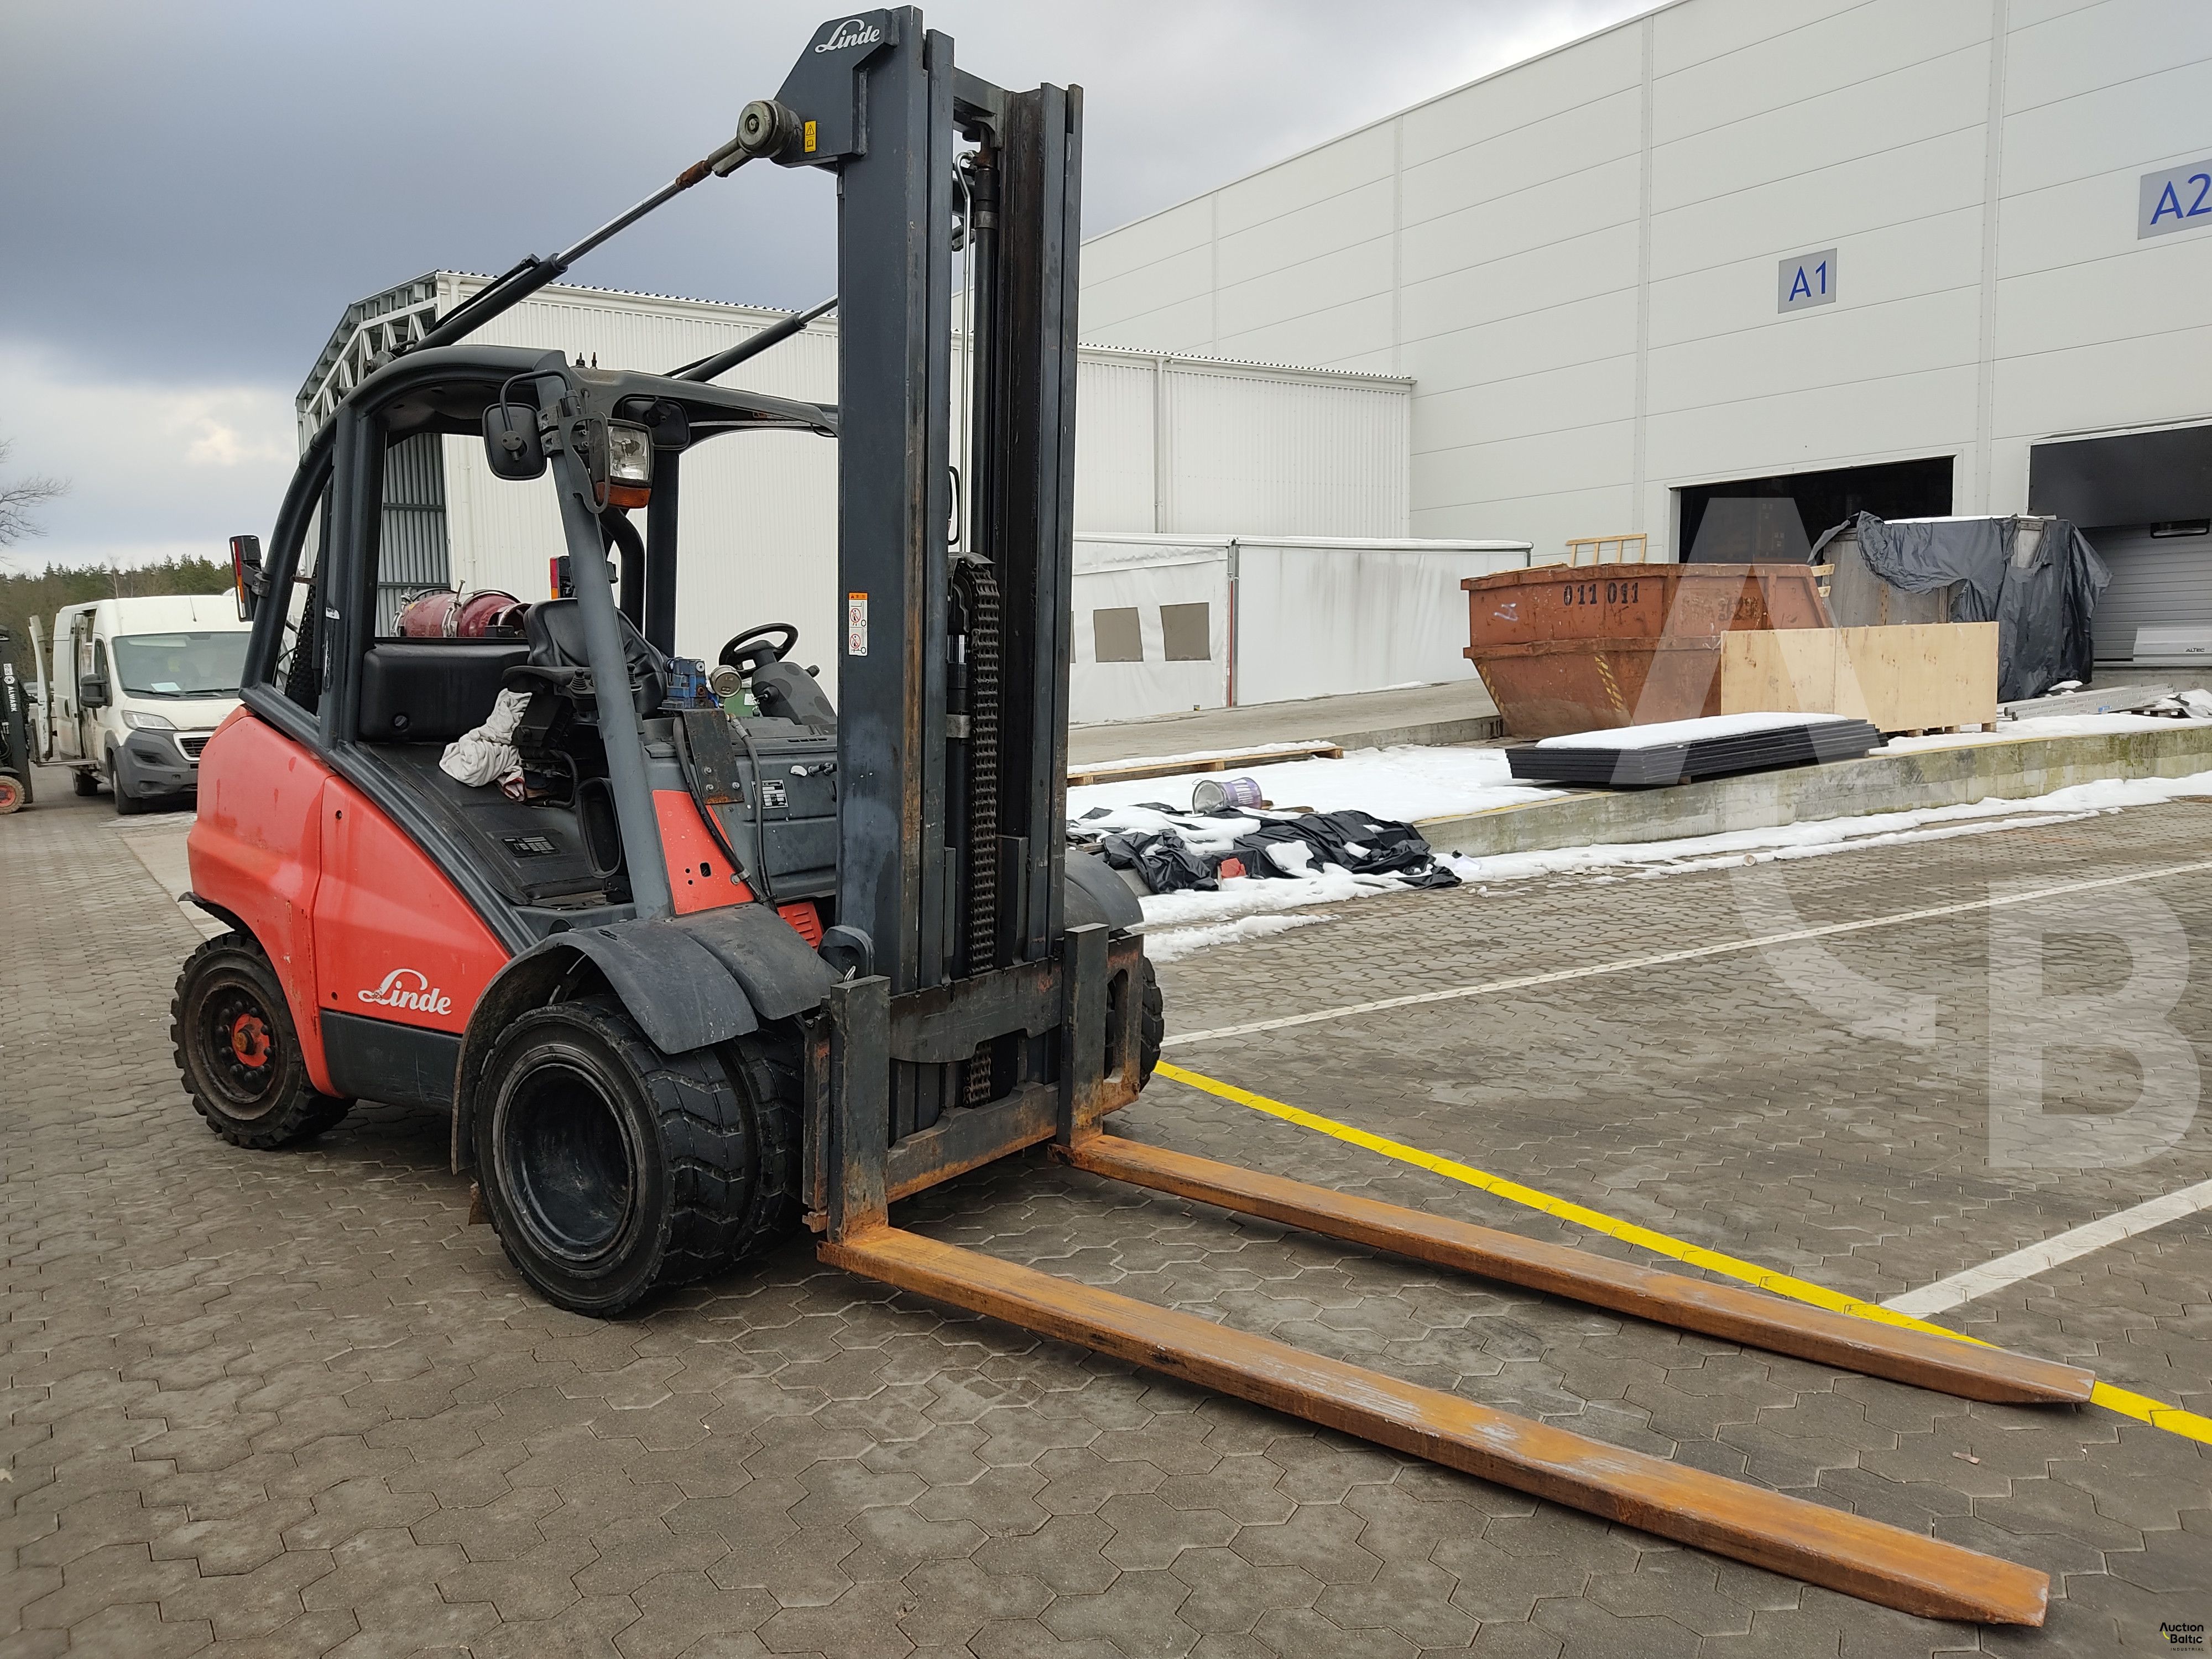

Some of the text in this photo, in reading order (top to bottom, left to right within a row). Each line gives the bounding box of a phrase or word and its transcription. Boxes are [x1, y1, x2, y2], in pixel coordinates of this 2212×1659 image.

[815, 19, 880, 53] Linde
[2150, 173, 2212, 226] A2
[1788, 260, 1826, 302] A1
[1564, 582, 1639, 606] 011 011
[7, 686, 18, 712] ALWARK
[358, 968, 452, 1015] Linde
